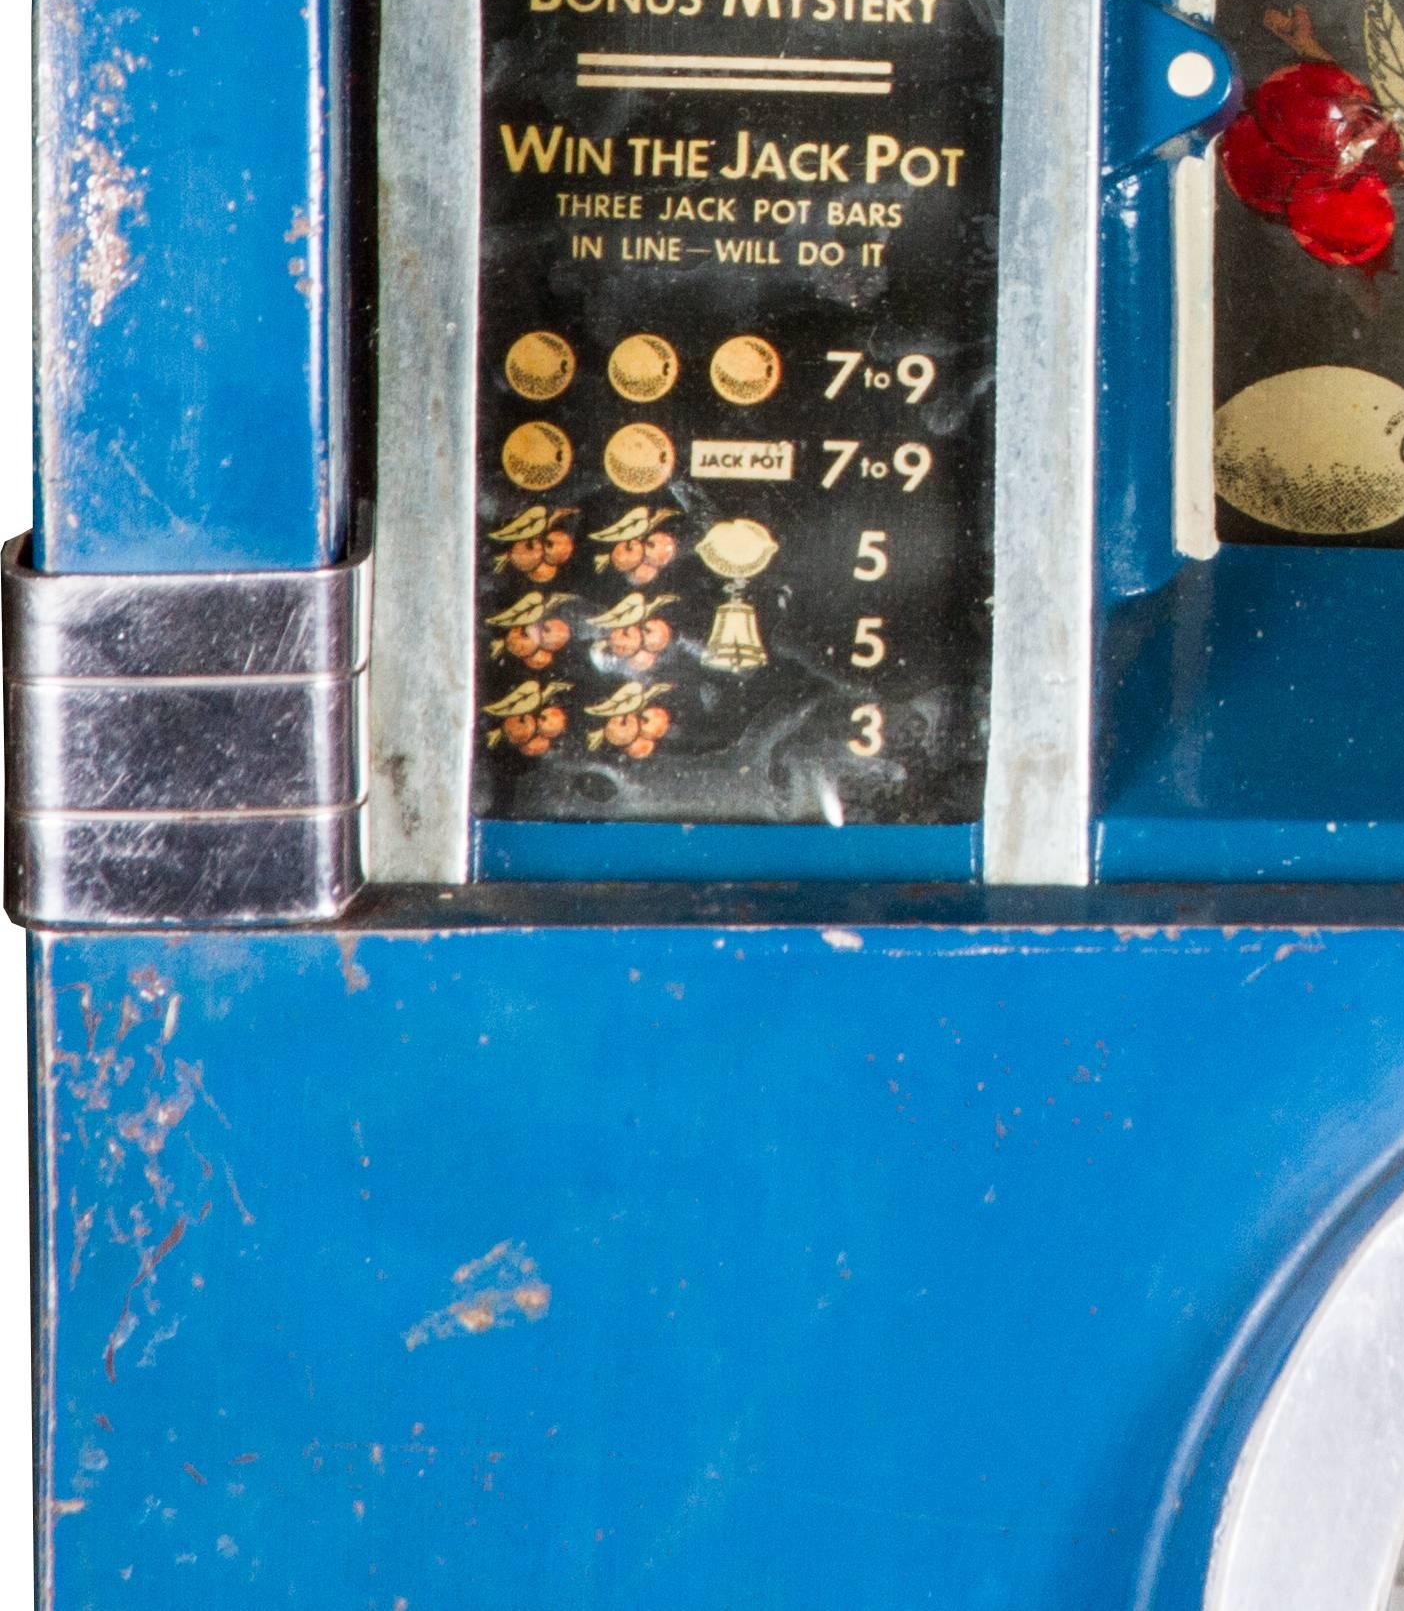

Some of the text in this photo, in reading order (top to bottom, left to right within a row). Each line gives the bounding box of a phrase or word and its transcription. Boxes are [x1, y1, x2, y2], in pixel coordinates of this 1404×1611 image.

[557, 193, 902, 228] THREE JACK POT BARS
[572, 235, 603, 260] IN
[798, 241, 845, 267] DO
[861, 243, 885, 268] IT
[824, 351, 935, 404] 7 to 9
[699, 440, 932, 492] JACK POT 7 to 9
[853, 530, 888, 582] 5
[850, 617, 885, 668] 5
[845, 704, 884, 760] 3
